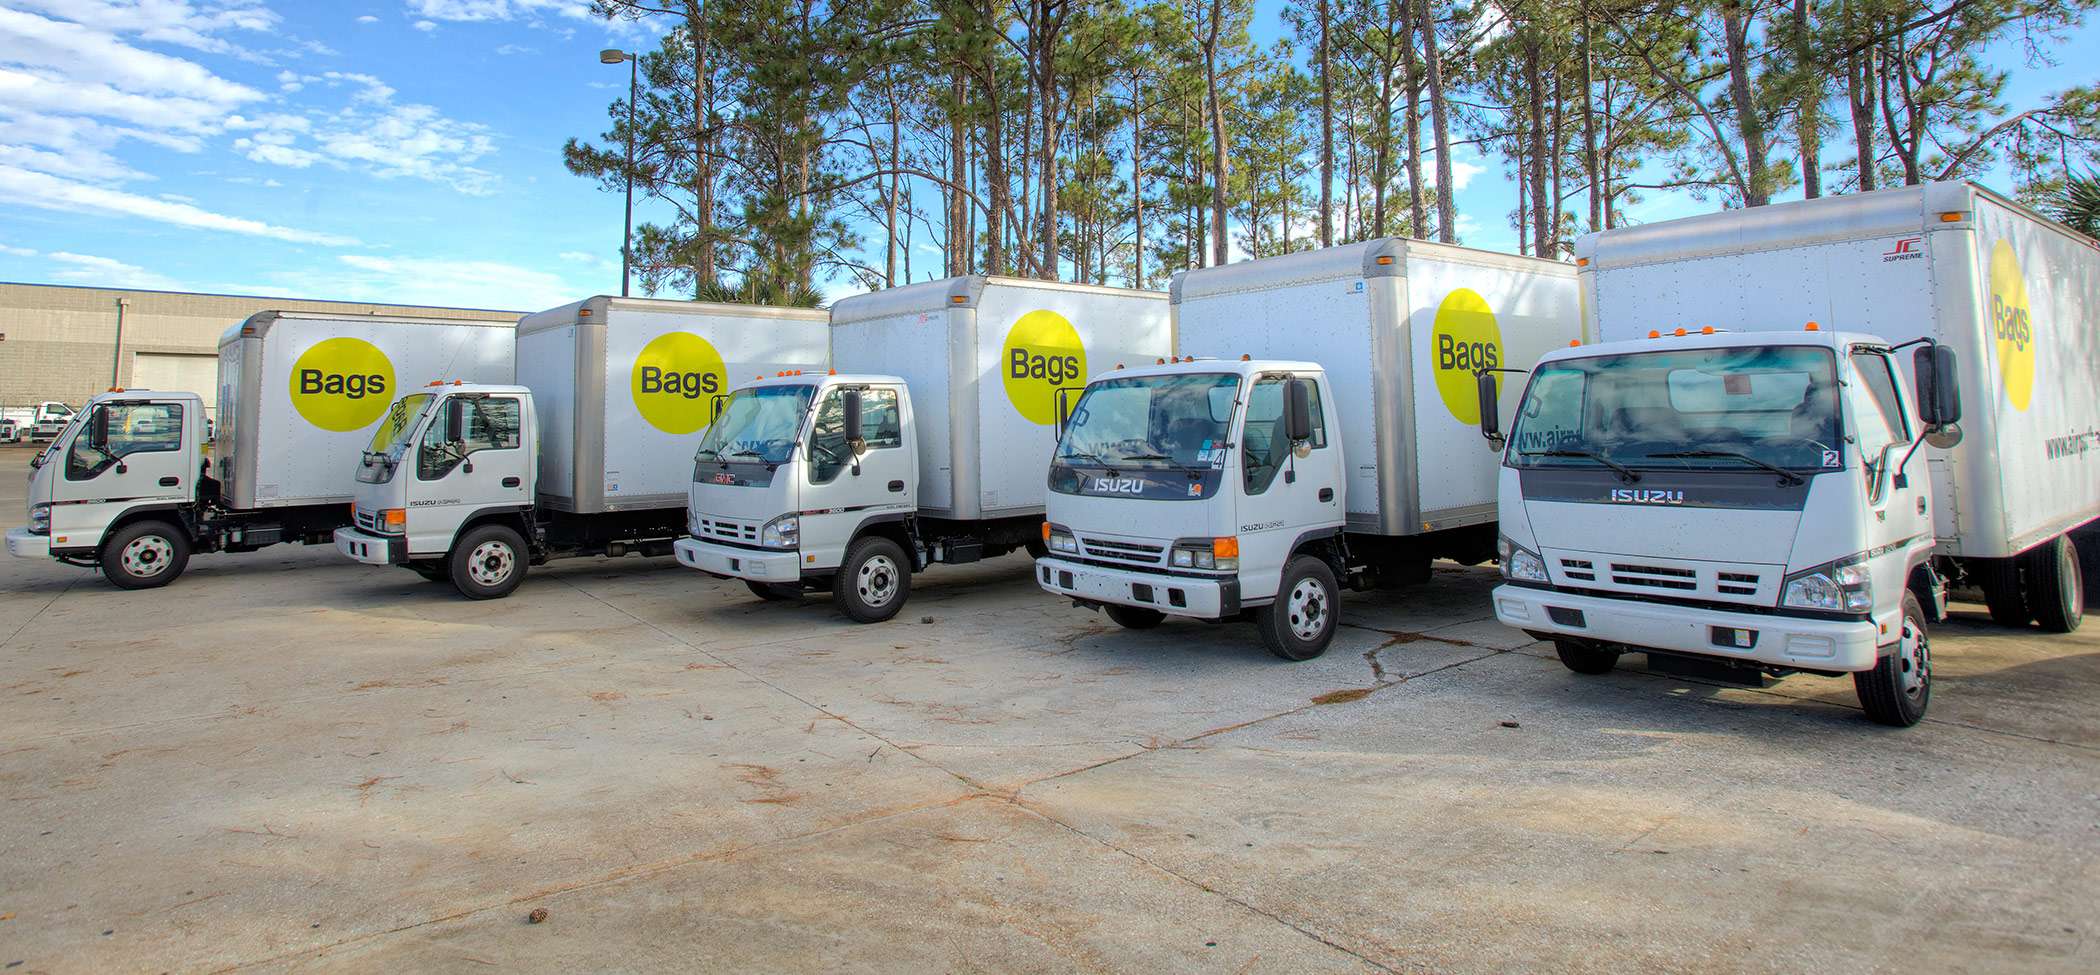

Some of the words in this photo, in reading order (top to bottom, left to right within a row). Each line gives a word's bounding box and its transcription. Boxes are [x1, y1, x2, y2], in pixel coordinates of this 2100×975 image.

[1883, 252, 1923, 262] SUPREME
[1994, 294, 2030, 351] Bags
[1439, 334, 1498, 377] Bags
[1011, 348, 1079, 385] Bags
[301, 369, 385, 399] Bags
[641, 366, 719, 399] Bags
[1213, 450, 1224, 468] 4
[1824, 451, 1837, 466] 2
[1094, 478, 1144, 493] ISUZU
[1611, 489, 1684, 504] ISUZU
[1240, 524, 1264, 532] ISUZU
